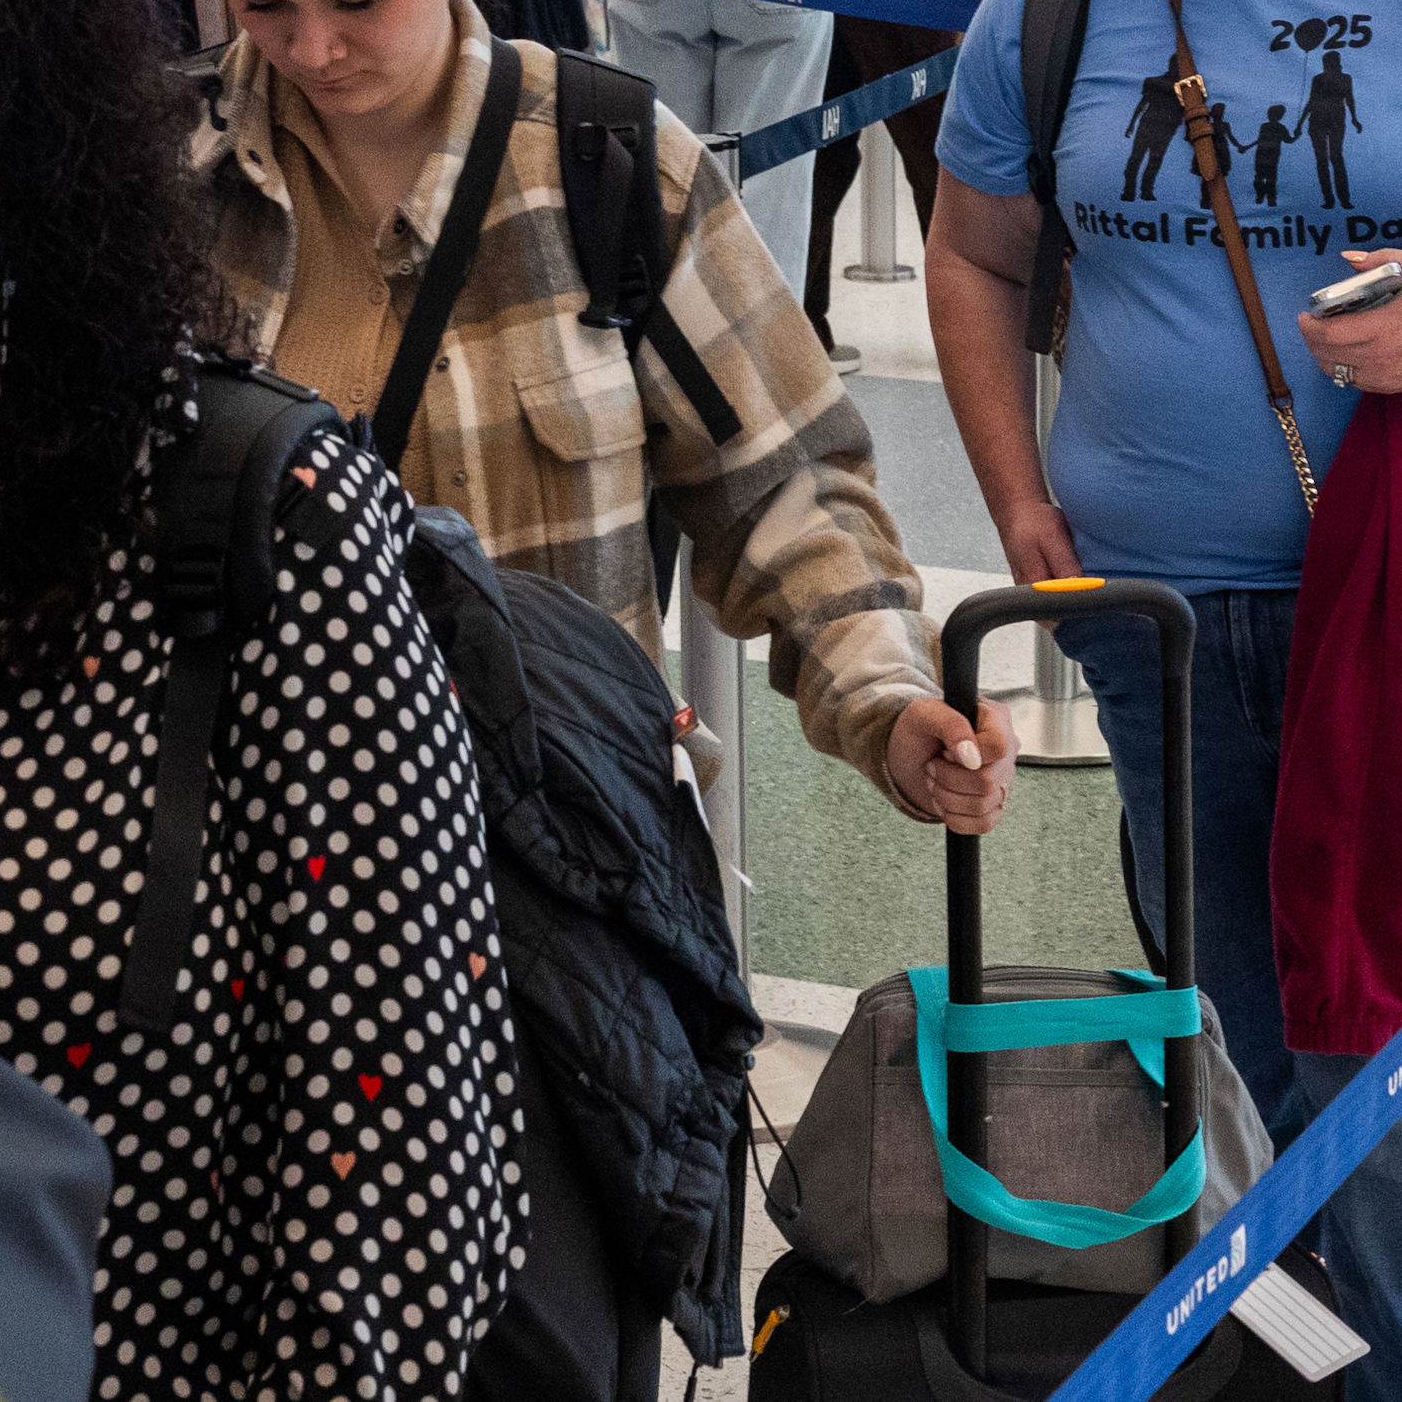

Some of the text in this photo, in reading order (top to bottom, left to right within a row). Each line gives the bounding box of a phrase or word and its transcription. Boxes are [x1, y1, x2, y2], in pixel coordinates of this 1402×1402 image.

[822, 105, 841, 140] IAH
[1074, 201, 1170, 244] Rittal
[1165, 1255, 1229, 1336] UNITED
